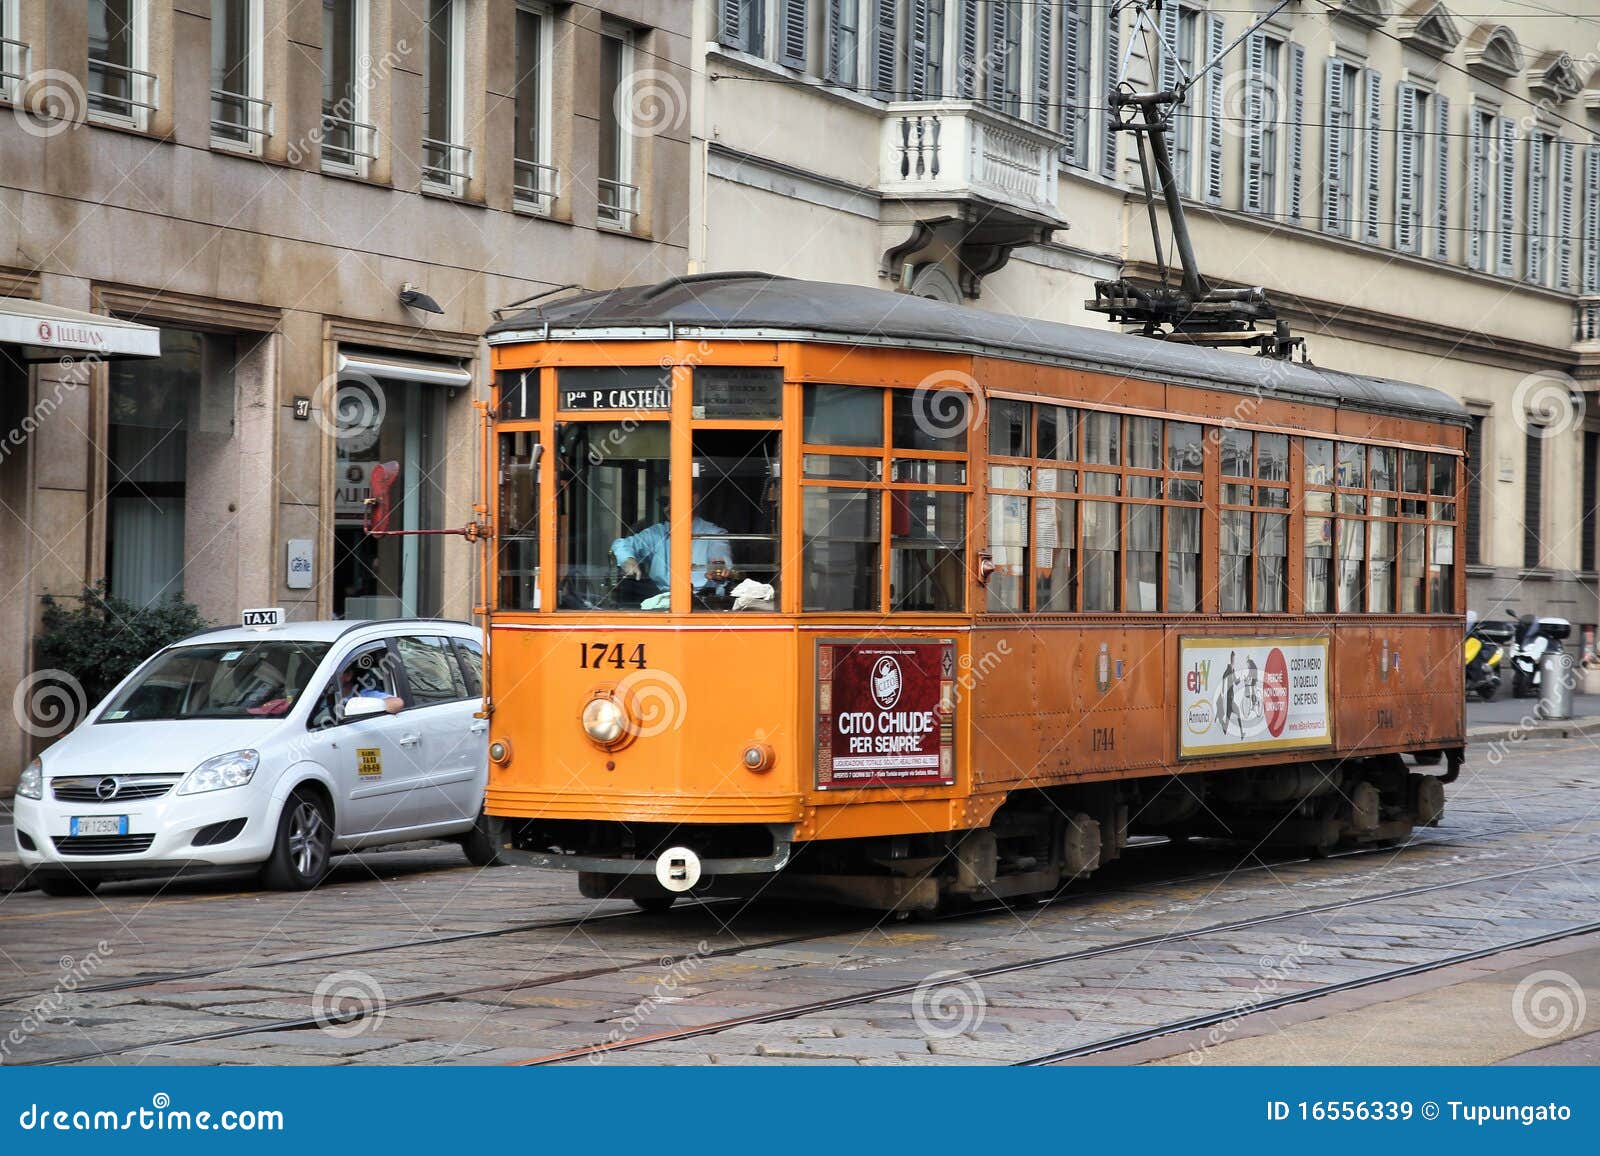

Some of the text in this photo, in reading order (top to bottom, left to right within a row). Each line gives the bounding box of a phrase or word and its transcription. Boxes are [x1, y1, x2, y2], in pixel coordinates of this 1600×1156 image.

[297, 400, 309, 416] 37
[244, 612, 276, 624] TAXI
[580, 643, 647, 669] 1744
[838, 711, 933, 735] CITO CHIUDE
[1189, 710, 1210, 723] Annunci
[849, 735, 923, 753] PER SEMPRE.
[1092, 727, 1114, 751] 1744
